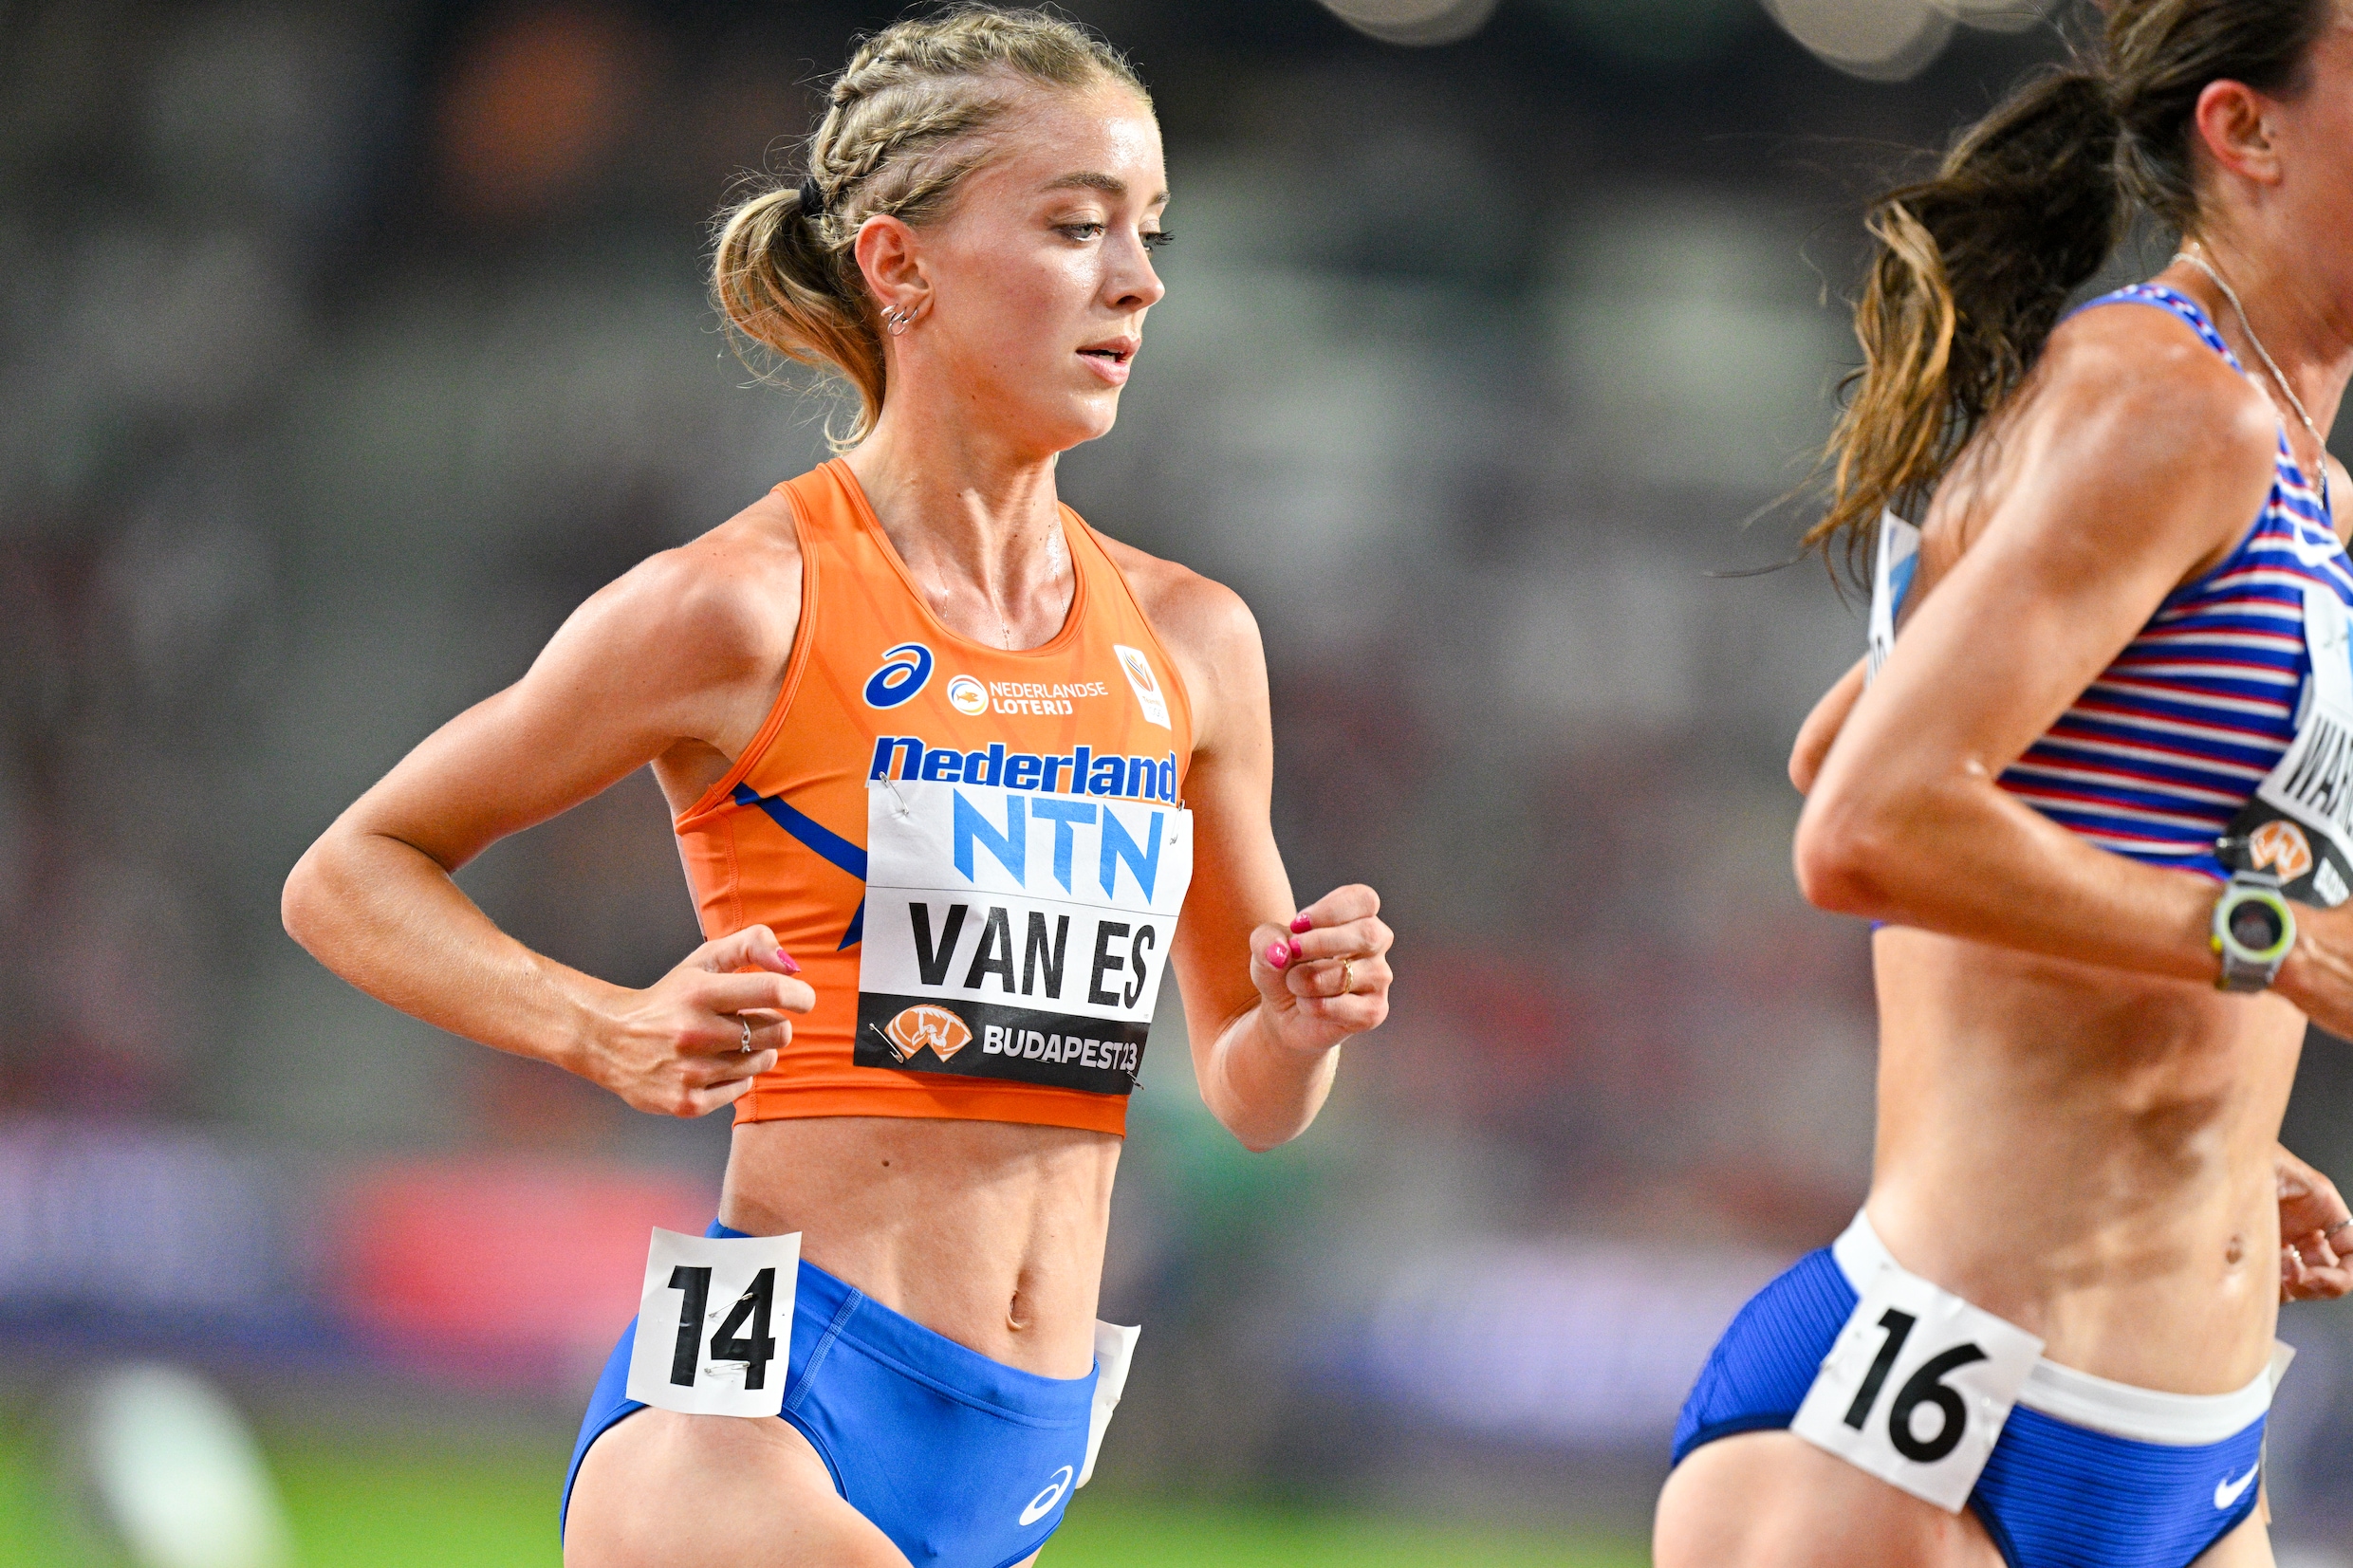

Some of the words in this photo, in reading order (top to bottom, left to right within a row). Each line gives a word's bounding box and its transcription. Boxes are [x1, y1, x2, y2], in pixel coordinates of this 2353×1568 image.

[990, 681, 1108, 698] NEDERLANDSE
[992, 698, 1073, 715] LOTERIJ
[954, 787, 1164, 906] NTN
[909, 902, 1070, 1000] VAN
[1087, 919, 1156, 1009] ES
[982, 1024, 1138, 1071] BUDAPEST23
[667, 1265, 776, 1391] 14
[1843, 1307, 1992, 1464] 16
